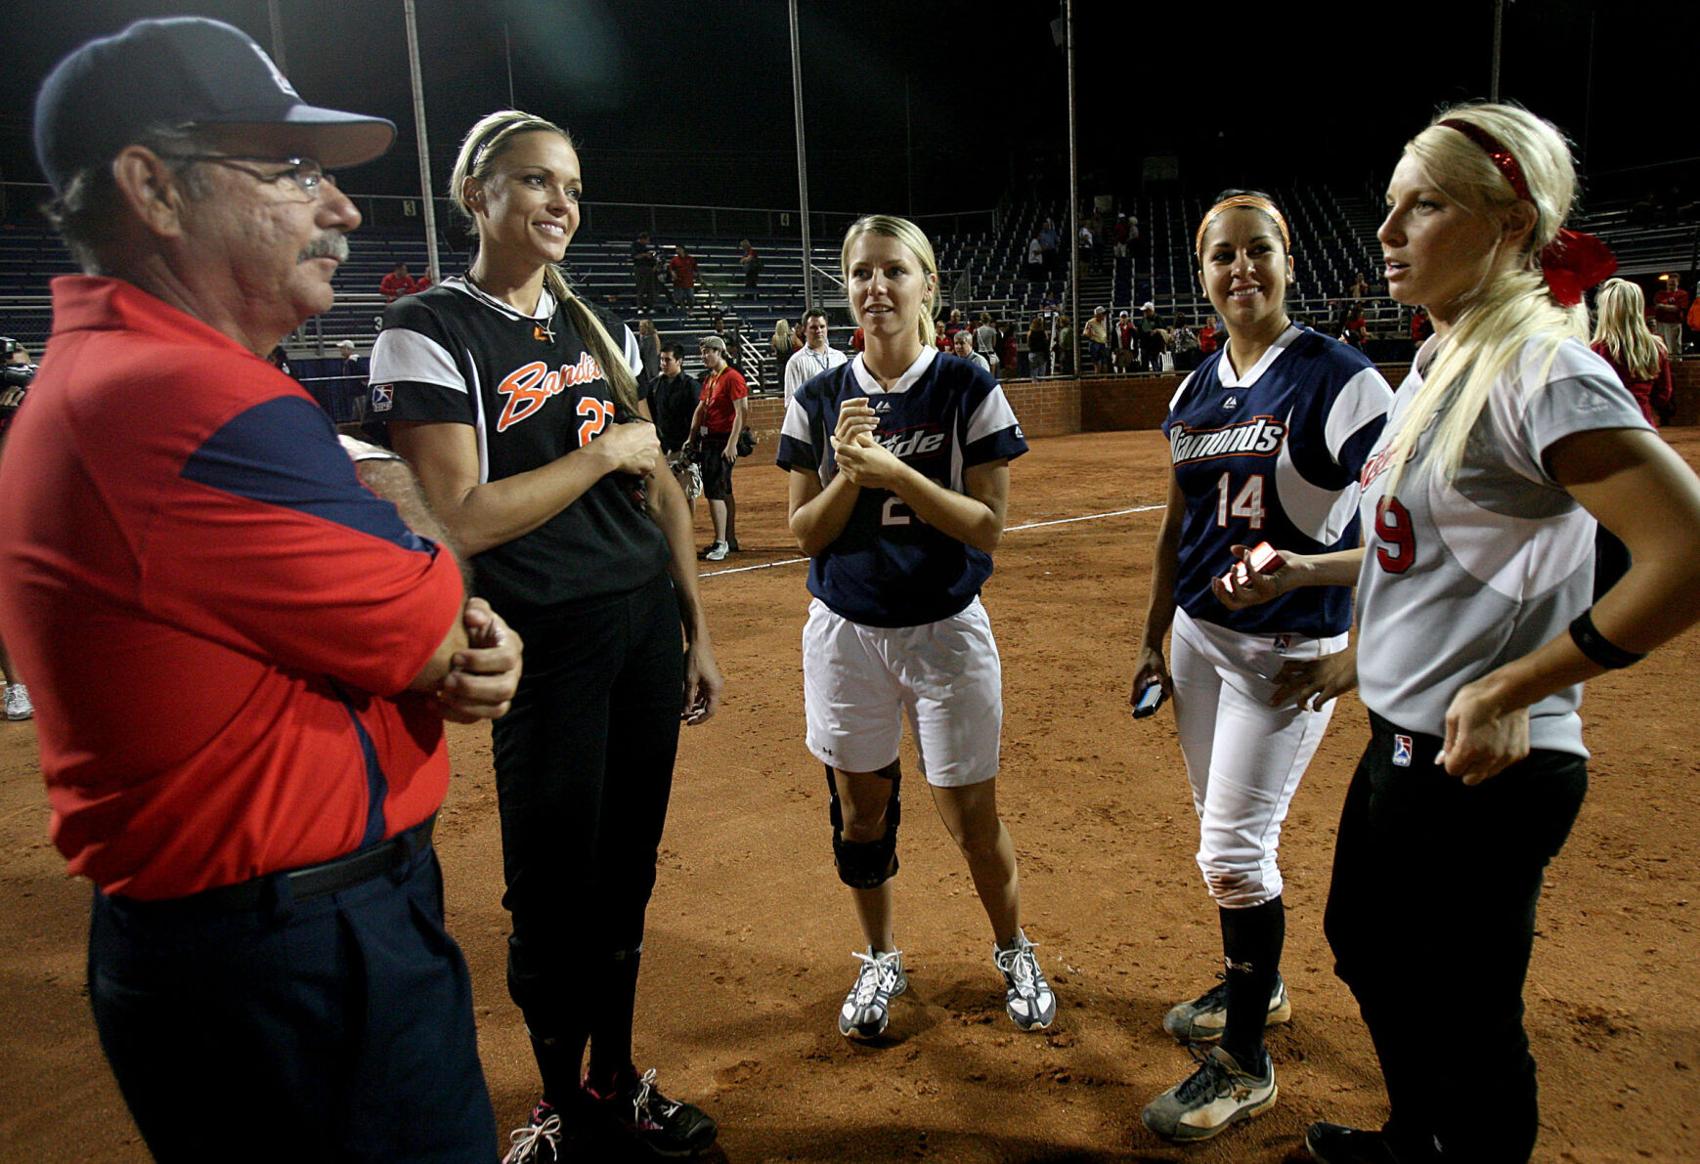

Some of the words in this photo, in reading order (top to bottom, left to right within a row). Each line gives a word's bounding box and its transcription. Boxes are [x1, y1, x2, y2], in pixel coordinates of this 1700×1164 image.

[374, 316, 383, 331] 3
[1170, 419, 1283, 464] Diamonds
[1216, 472, 1266, 529] 14
[1375, 495, 1417, 574] 9
